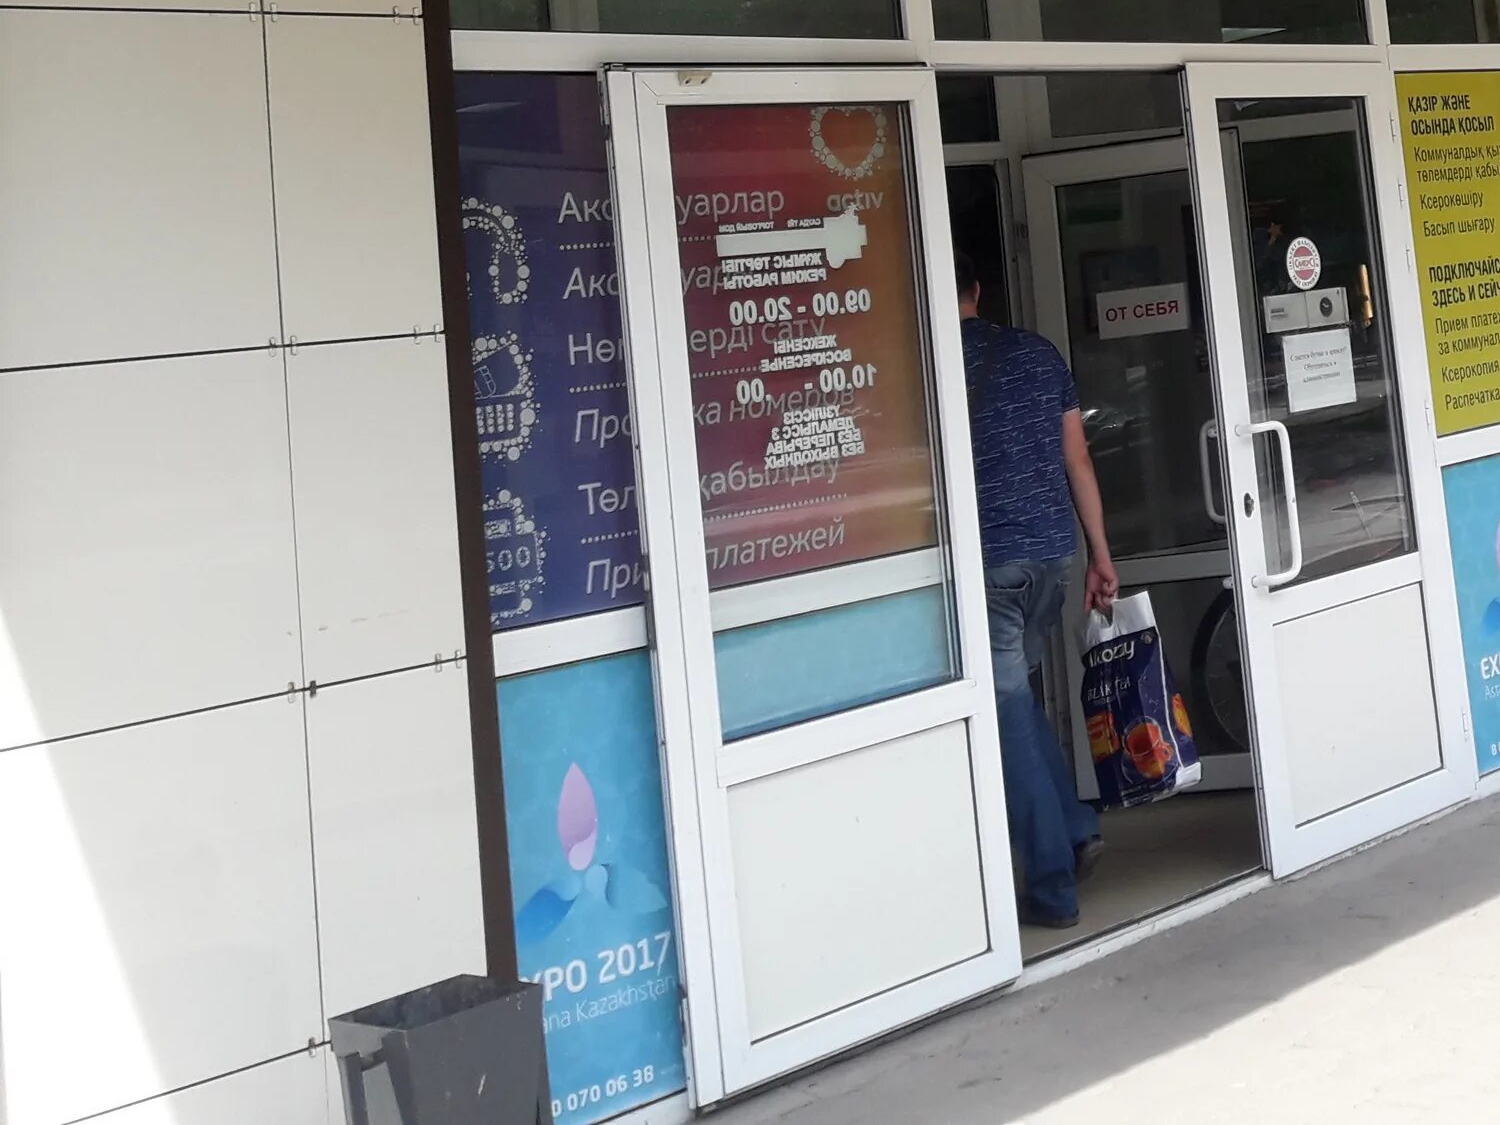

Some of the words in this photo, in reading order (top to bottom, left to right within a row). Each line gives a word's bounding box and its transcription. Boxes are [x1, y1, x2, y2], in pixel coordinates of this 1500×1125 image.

[1408, 94, 1439, 114] ҚАЗІР
[1441, 92, 1471, 111] ЖӘНЕ
[1411, 117, 1457, 136] ОСЫНДА
[1458, 115, 1495, 134] ҚОСЫЛ
[1413, 144, 1485, 165] Коммуналдық
[1417, 164, 1474, 183] төлемдерді
[1420, 190, 1484, 210] Ксерокөшіру
[1423, 220, 1456, 238] Басып
[1457, 217, 1495, 236] шығару
[1432, 286, 1465, 308] ЗДЕСЬ
[1468, 285, 1476, 301] И
[1105, 306, 1128, 322] ОТ
[1133, 300, 1179, 318] СЕБЯ
[1435, 313, 1468, 334] Прием
[1438, 339, 1451, 355] за
[1441, 359, 1500, 383] Ксерокопия
[1445, 386, 1500, 411] Распечатка
[1491, 743, 1497, 756] 8
[597, 930, 672, 985] 2017
[575, 973, 675, 1022] Kazakhstan
[567, 1085, 601, 1115] 070
[605, 1072, 628, 1096] 06
[632, 1063, 655, 1090] 38
